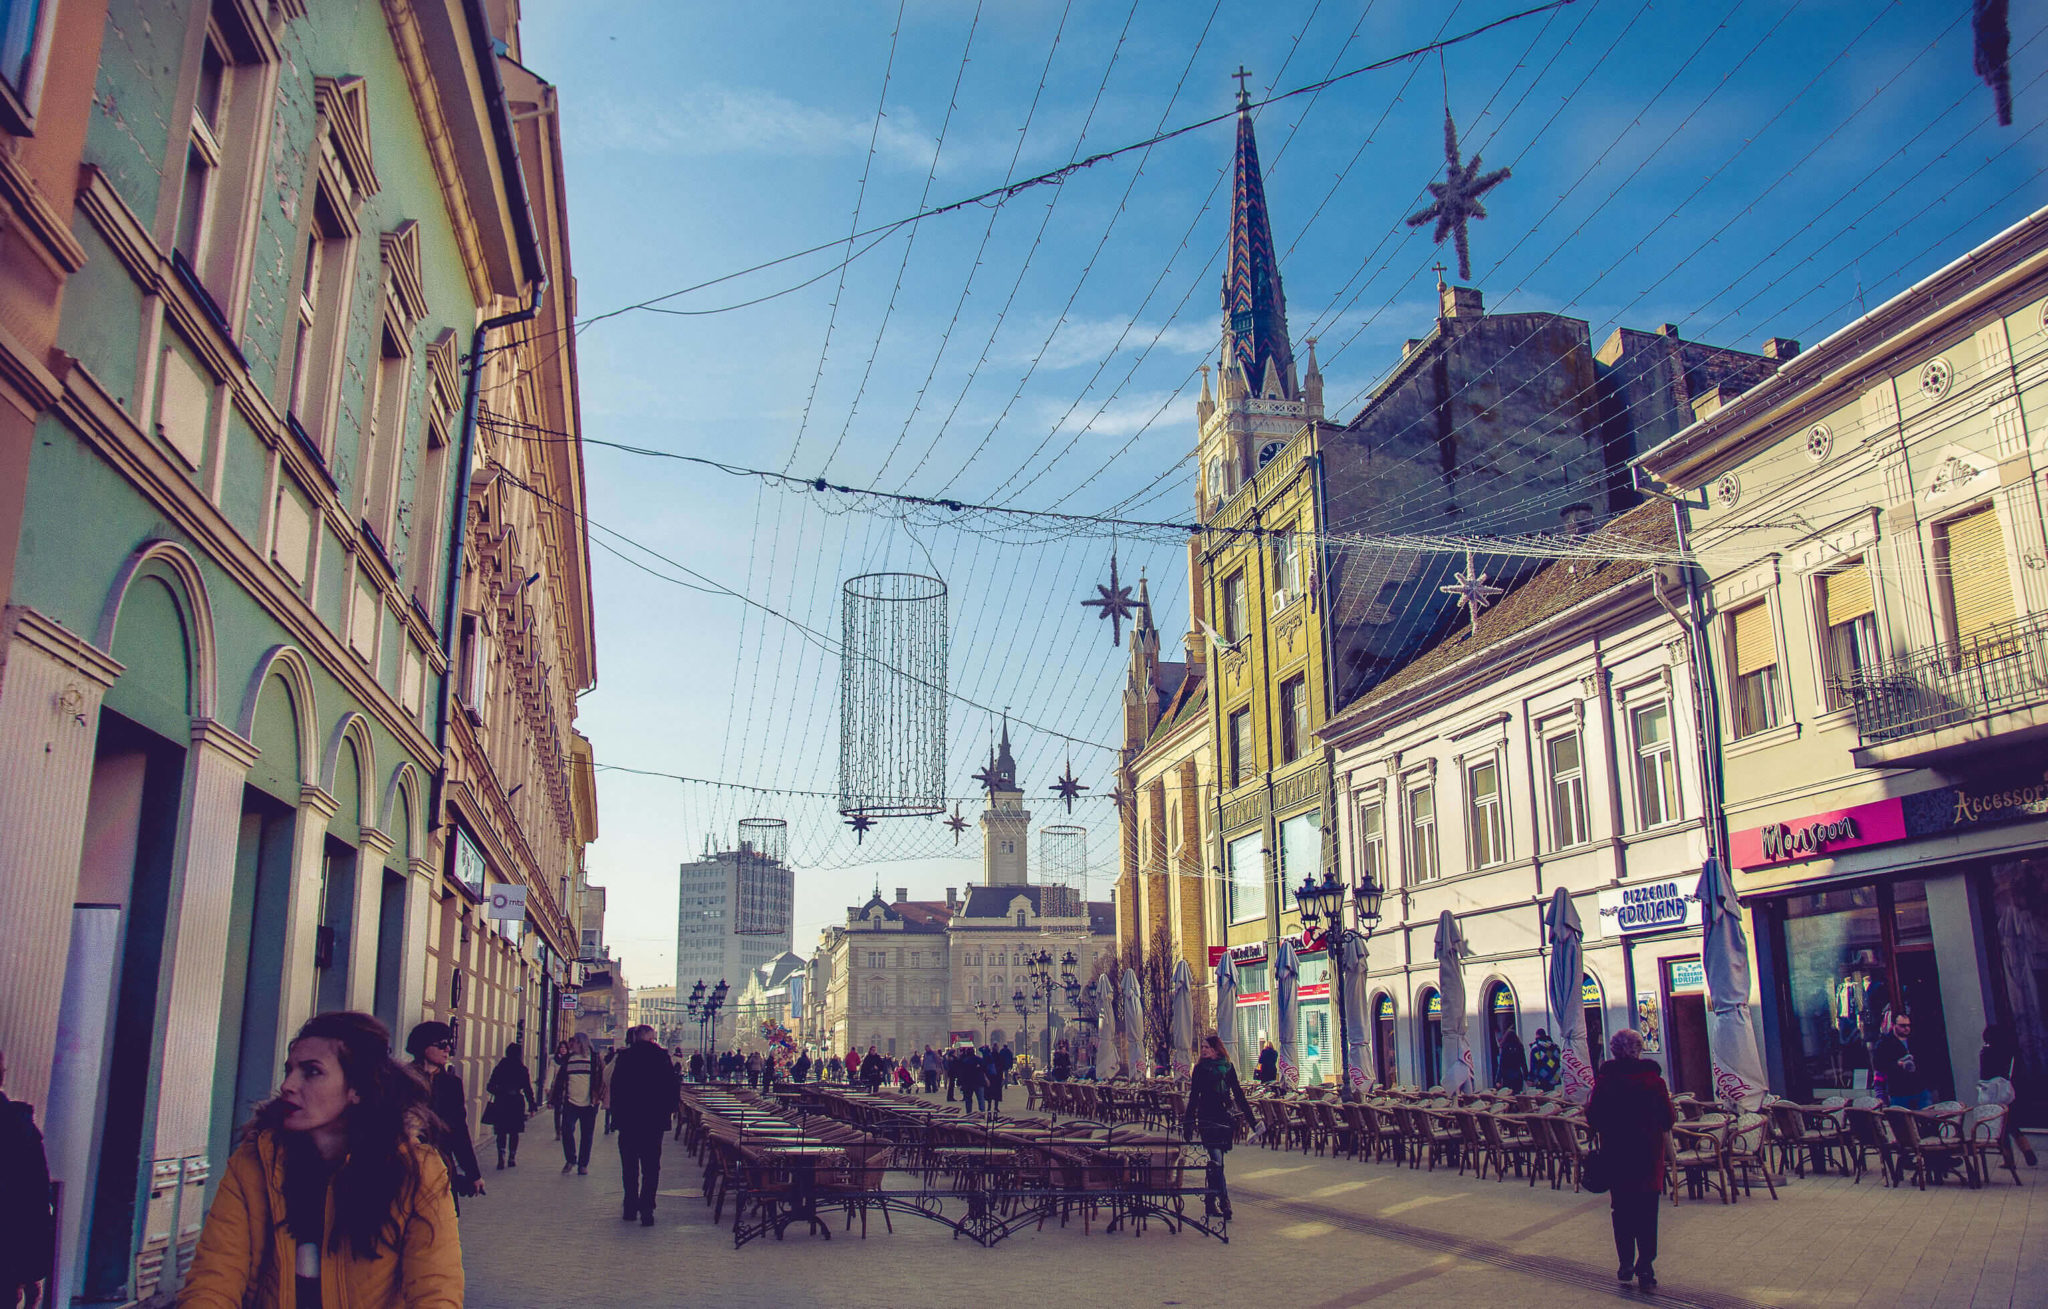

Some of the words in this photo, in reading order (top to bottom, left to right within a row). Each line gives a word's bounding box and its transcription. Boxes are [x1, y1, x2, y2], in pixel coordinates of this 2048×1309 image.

[1954, 784, 2048, 824] Accessor
[1760, 816, 1856, 860] Monsoon
[1623, 882, 1678, 905] PIZZERIA
[1618, 898, 1687, 926] ADRIJANA
